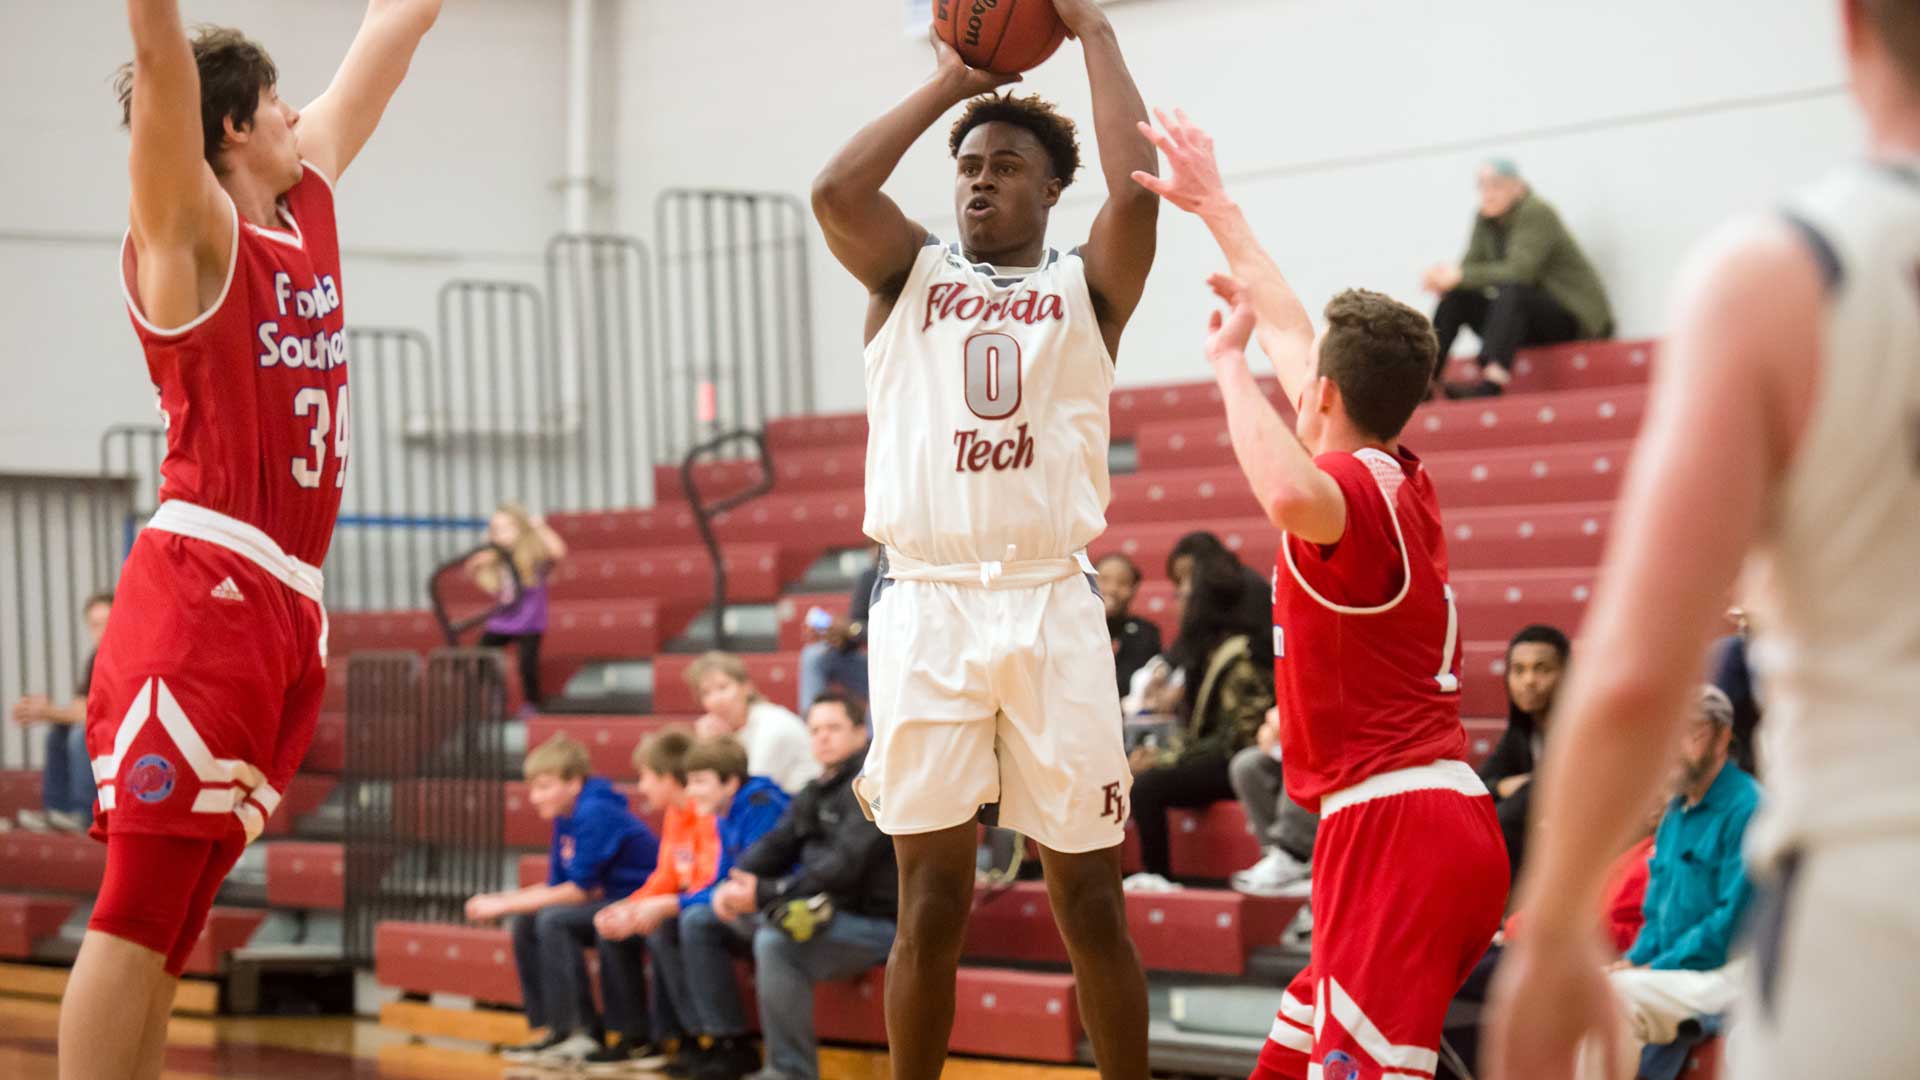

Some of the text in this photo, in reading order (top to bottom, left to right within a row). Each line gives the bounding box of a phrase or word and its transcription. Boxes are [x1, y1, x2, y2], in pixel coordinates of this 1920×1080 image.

[922, 281, 1064, 332] Florida
[964, 332, 1022, 421] 0
[291, 384, 349, 489] 34
[954, 422, 1034, 473] Tech
